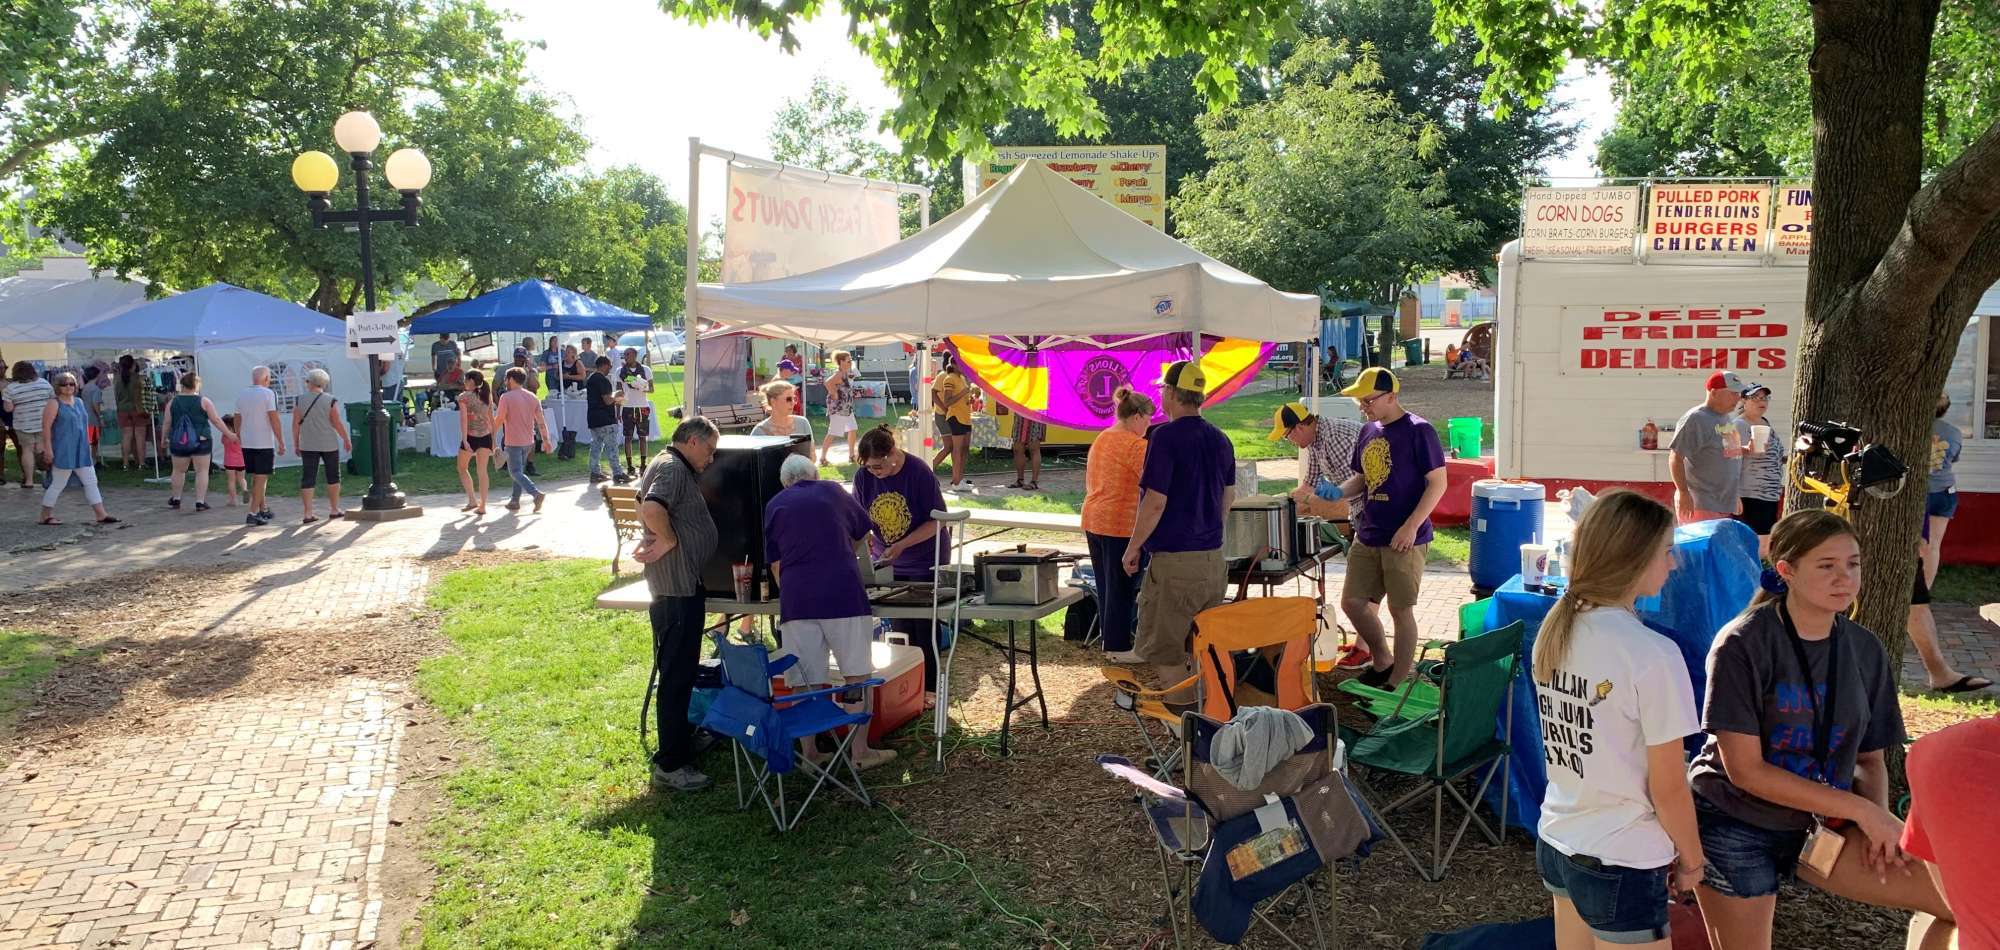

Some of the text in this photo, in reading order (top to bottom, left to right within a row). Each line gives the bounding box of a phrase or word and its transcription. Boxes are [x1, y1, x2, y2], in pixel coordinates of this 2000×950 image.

[1060, 151, 1107, 159] Lemonade
[1110, 150, 1160, 160] Shake-Ups
[1119, 177, 1148, 187] Peach
[1529, 192, 1552, 201] Hand
[1555, 192, 1587, 203] Dipped
[1656, 190, 1761, 203] PULLED PORK
[1536, 205, 1624, 222] CORN DOGS
[1656, 205, 1760, 219] TENDERLOINS
[1526, 228, 1547, 239] CORN
[1599, 228, 1634, 239] BURGERS
[1655, 222, 1758, 236] BURGERS
[1653, 237, 1757, 252] CHICKEN
[1603, 308, 1766, 322] DEEP
[1583, 323, 1788, 340] FRIED
[1580, 348, 1787, 369] DELIGHTS
